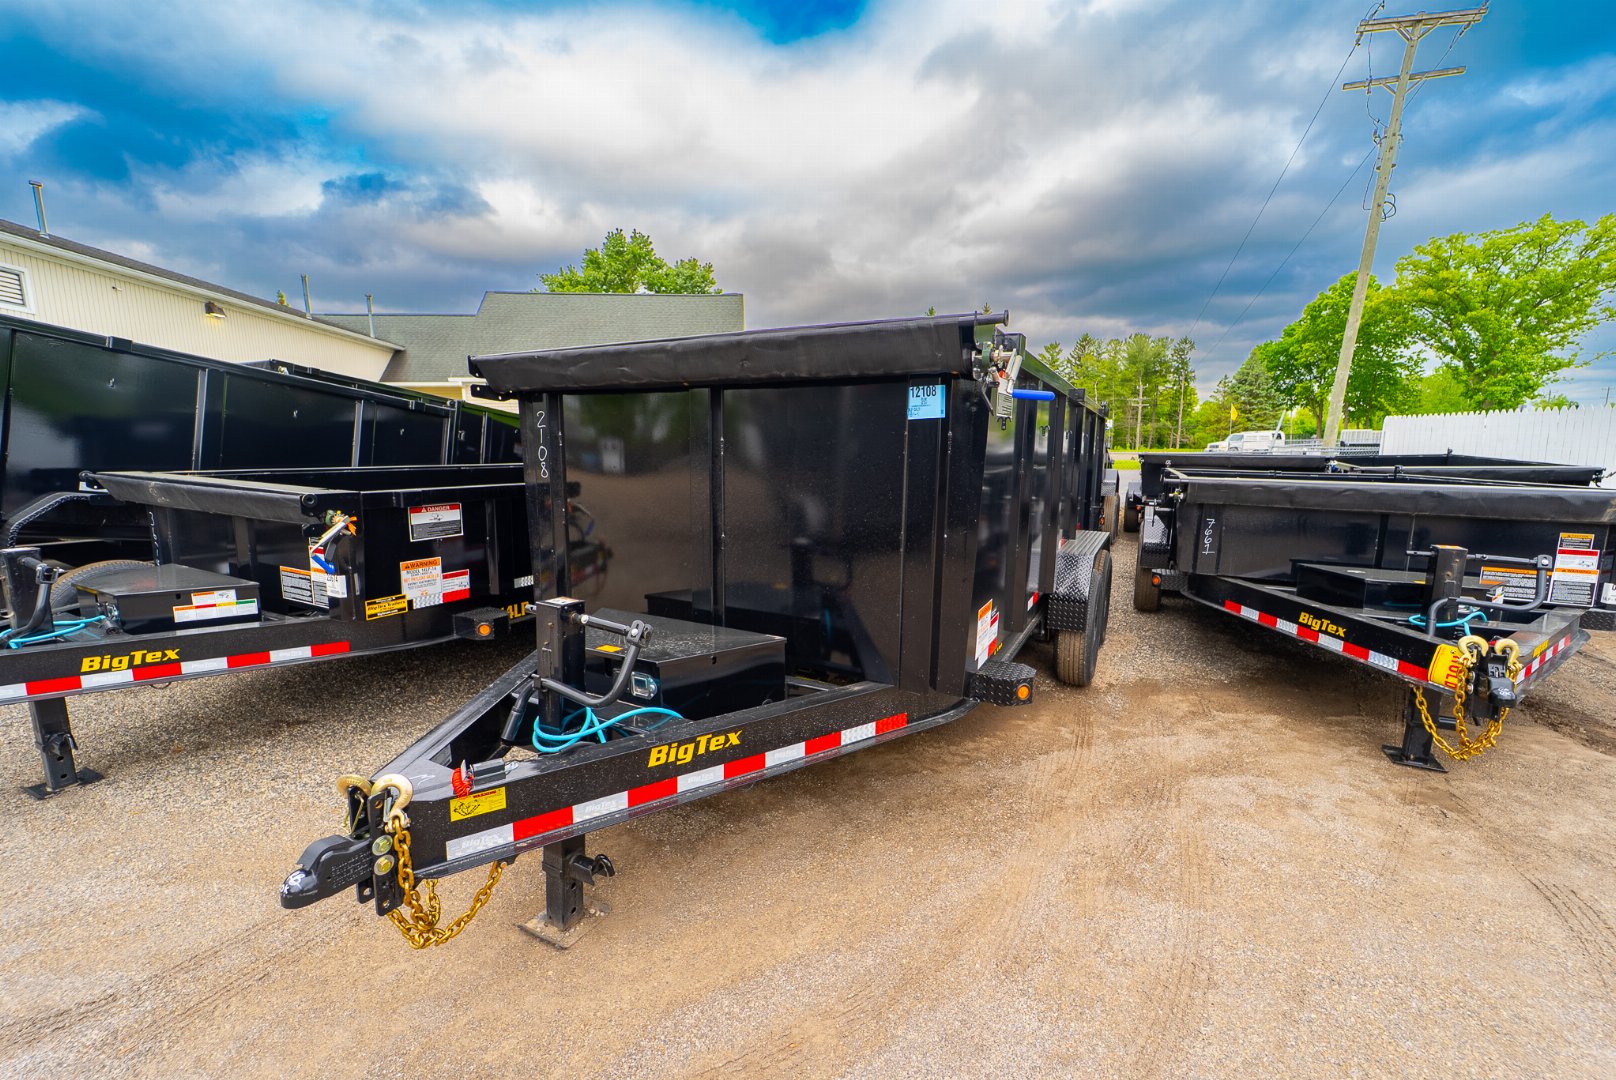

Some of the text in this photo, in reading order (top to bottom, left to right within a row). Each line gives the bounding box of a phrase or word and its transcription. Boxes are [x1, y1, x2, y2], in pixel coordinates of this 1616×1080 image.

[910, 386, 937, 398] 12108
[536, 410, 549, 478] 2108
[409, 559, 438, 569] WARNING
[1298, 611, 1347, 638] BigTex
[80, 648, 181, 673] BigTex
[647, 729, 744, 768] BigTex
